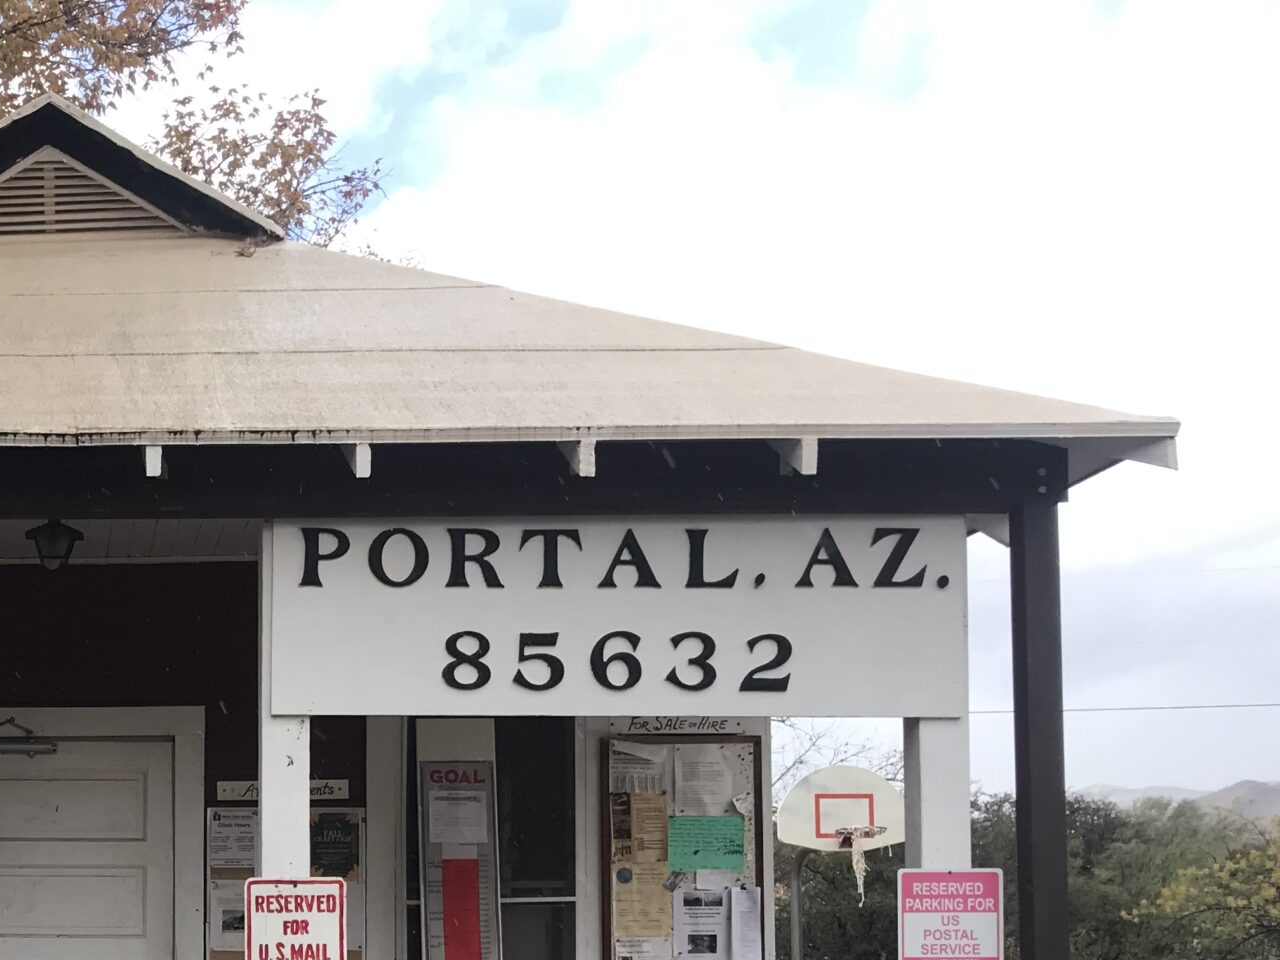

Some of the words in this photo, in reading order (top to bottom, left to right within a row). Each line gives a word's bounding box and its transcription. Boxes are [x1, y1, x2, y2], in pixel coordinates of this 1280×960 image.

[298, 526, 767, 589] PORTAL,
[793, 527, 951, 589] AZ.
[441, 630, 793, 693] 85632
[653, 716, 687, 732] SALE
[697, 716, 728, 732] HIRE
[428, 768, 487, 784] GOAL
[912, 882, 983, 895] RESERVED
[255, 894, 337, 913] RESERVED
[905, 898, 964, 911] PARKING
[967, 898, 995, 910] FOR
[283, 920, 309, 935] FOR
[941, 915, 960, 926] US
[923, 929, 978, 941] POSTAL
[921, 944, 981, 955] SERVICE
